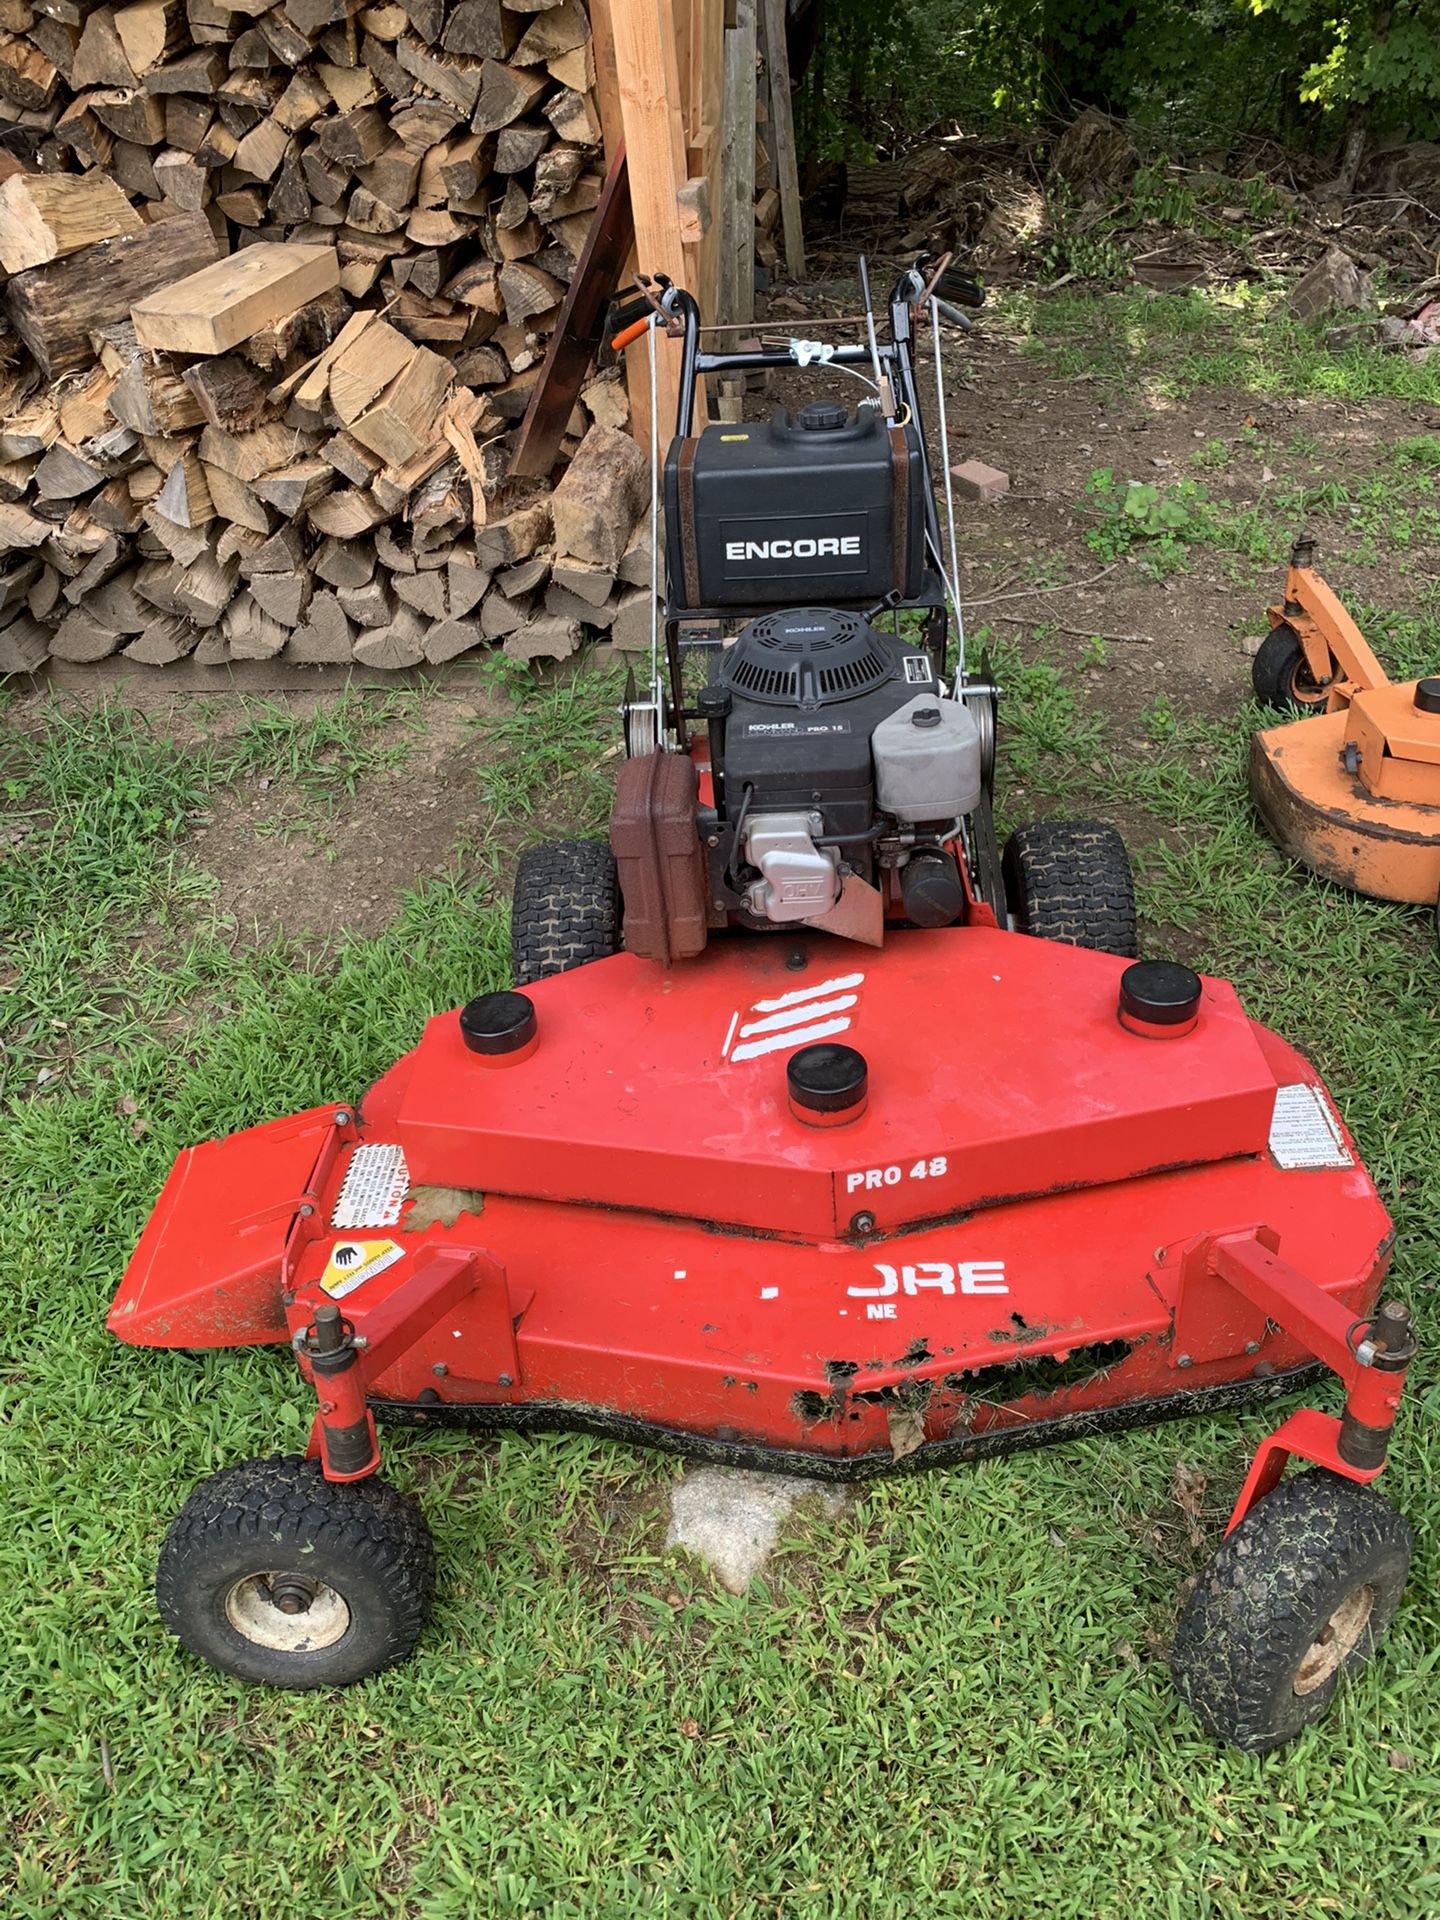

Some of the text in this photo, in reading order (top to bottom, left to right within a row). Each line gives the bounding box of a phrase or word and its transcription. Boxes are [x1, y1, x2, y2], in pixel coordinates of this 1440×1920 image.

[726, 537, 860, 560] ENCORE
[785, 626, 826, 634] KOHLER
[748, 722, 795, 731] KOHLER
[847, 1156, 947, 1193] PRO 48
[866, 1304, 897, 1319] NE
